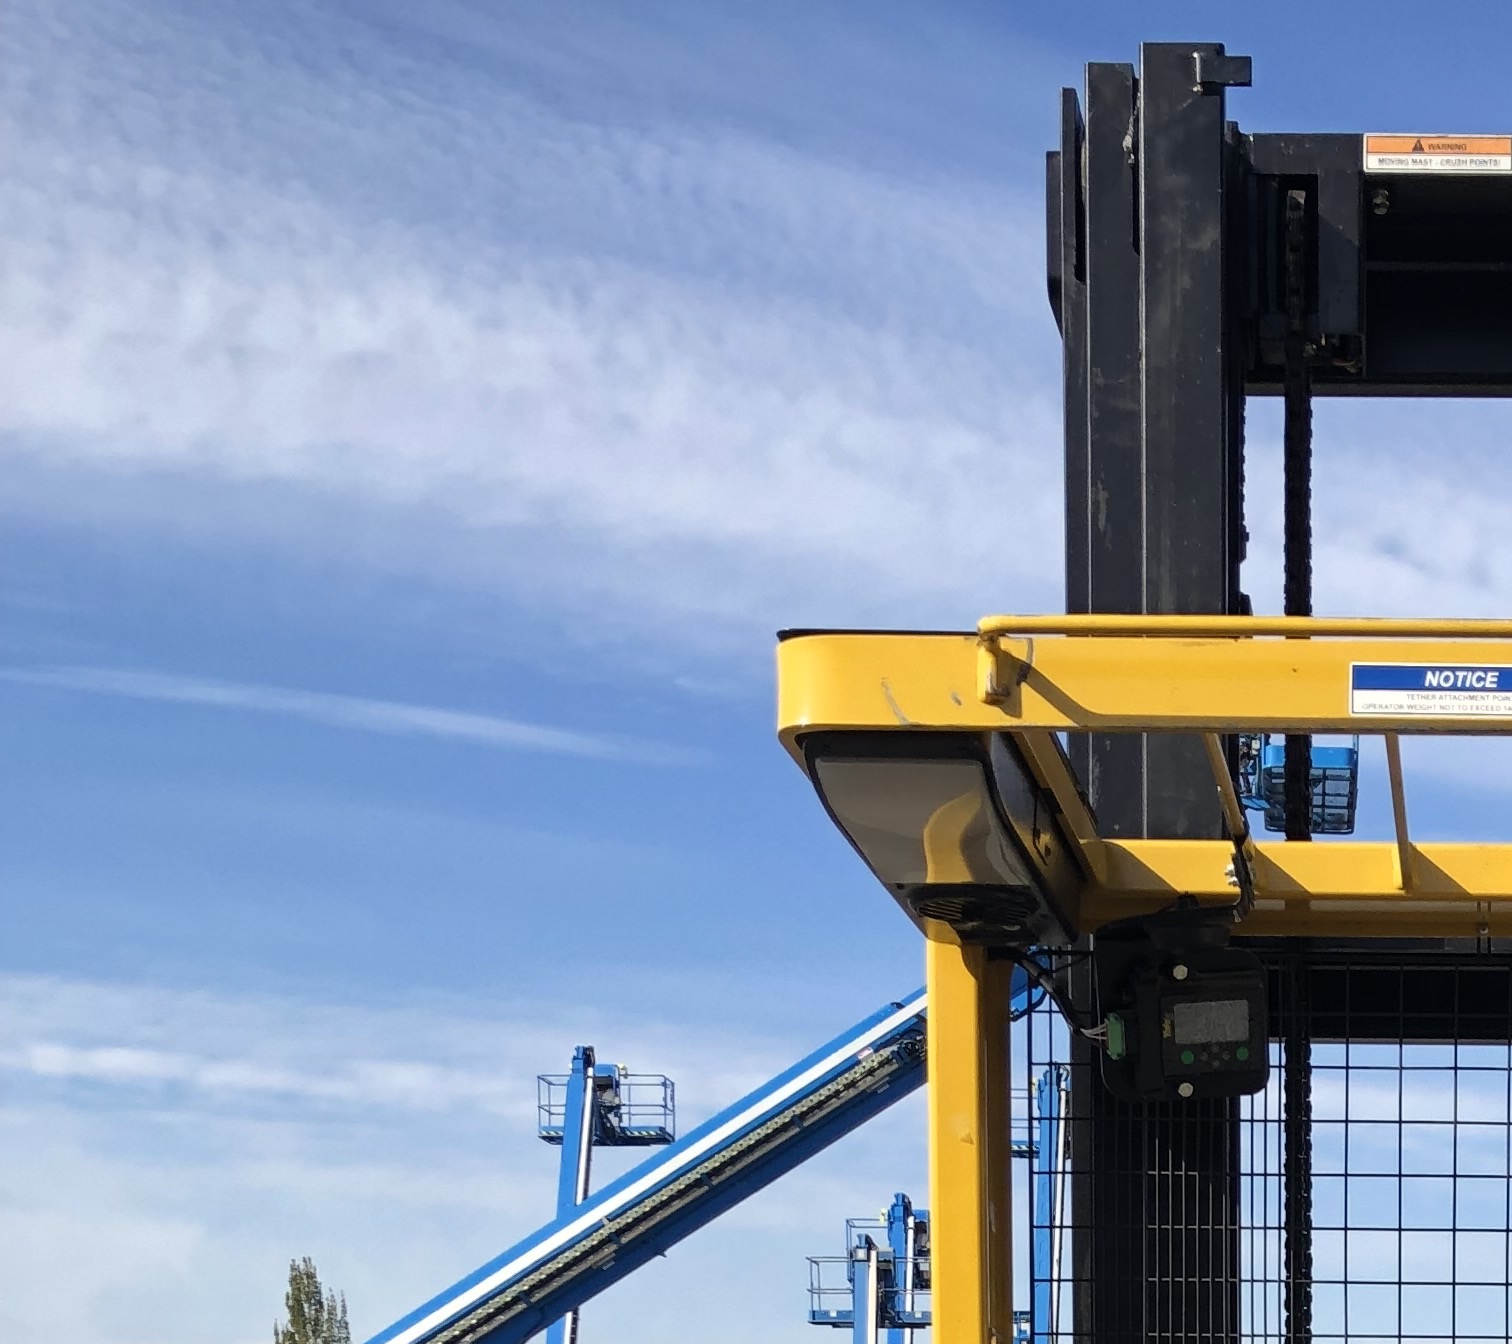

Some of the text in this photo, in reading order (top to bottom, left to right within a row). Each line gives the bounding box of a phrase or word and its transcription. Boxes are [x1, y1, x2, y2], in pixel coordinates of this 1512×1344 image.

[1378, 157, 1409, 166] MOVING
[1411, 158, 1433, 166] MAST
[1440, 158, 1468, 167] CRUSH
[1424, 670, 1499, 688] NOTICE
